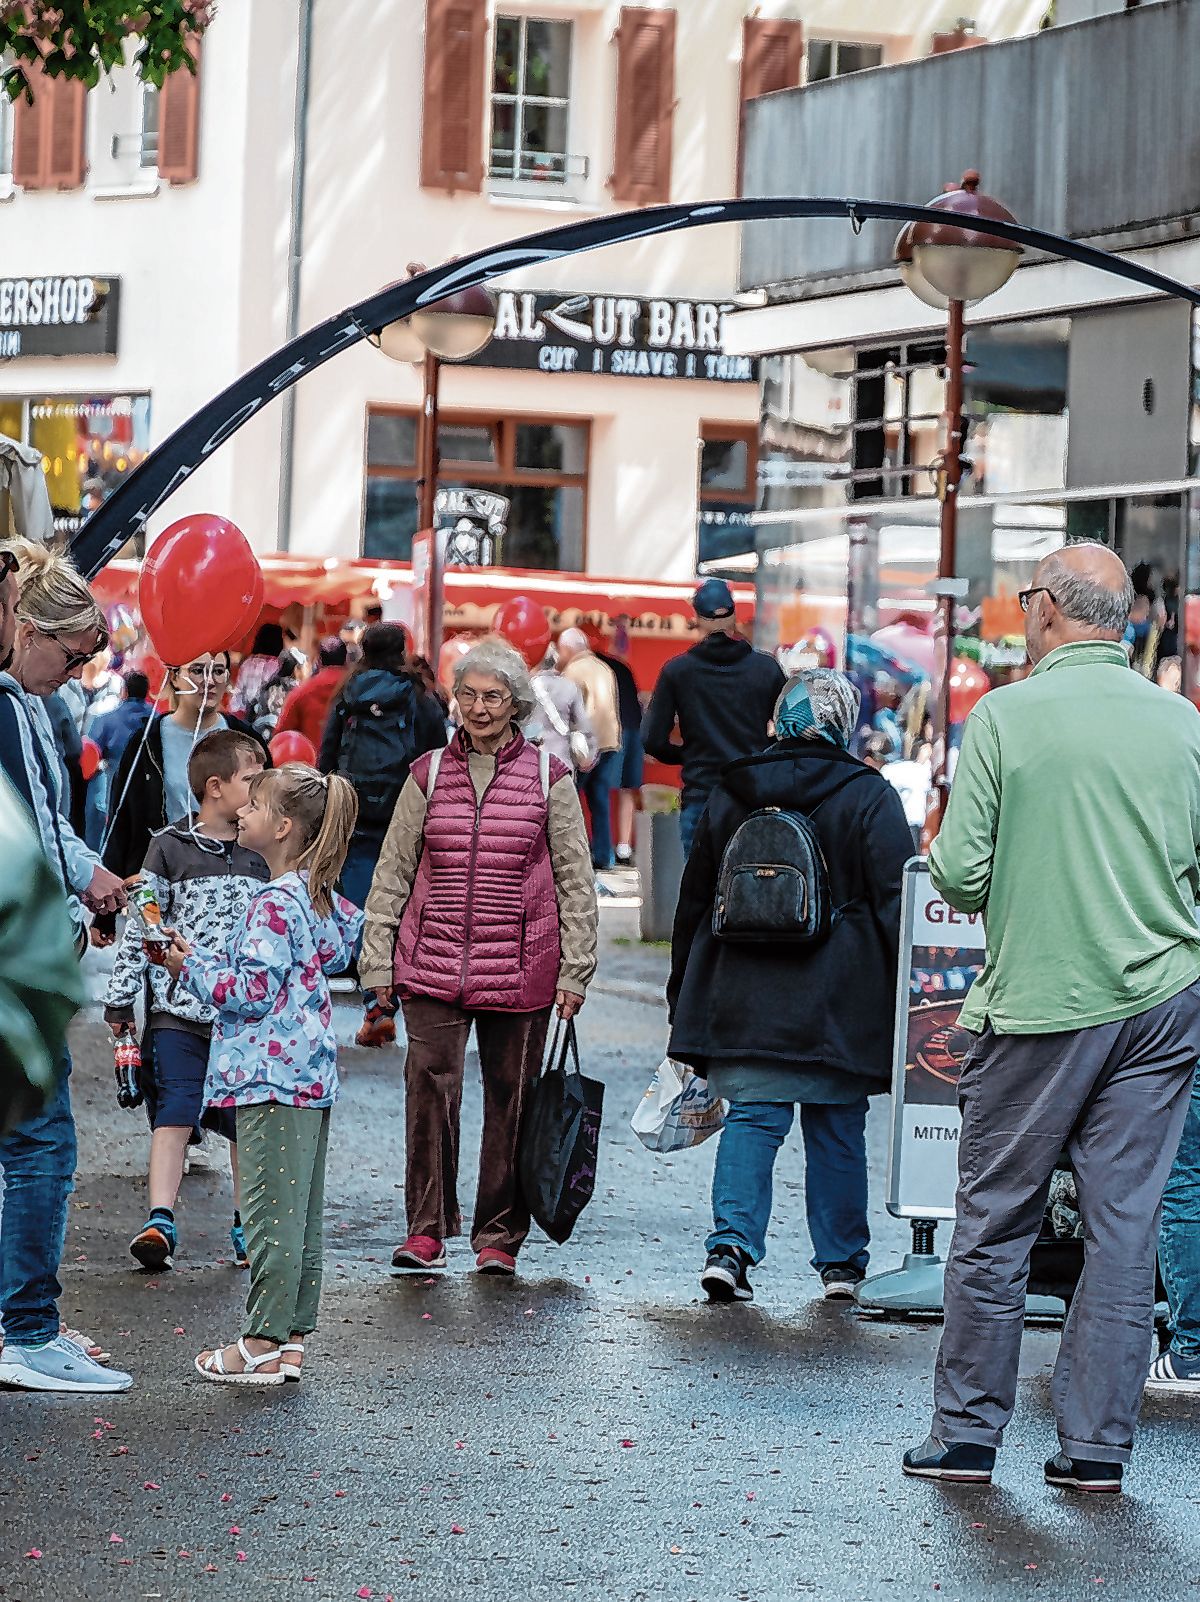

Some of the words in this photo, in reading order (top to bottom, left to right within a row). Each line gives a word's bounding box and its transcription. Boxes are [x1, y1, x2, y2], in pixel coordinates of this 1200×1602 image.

[538, 345, 578, 371] CUT
[611, 349, 678, 376] SHAVE
[704, 354, 752, 379] TRIM
